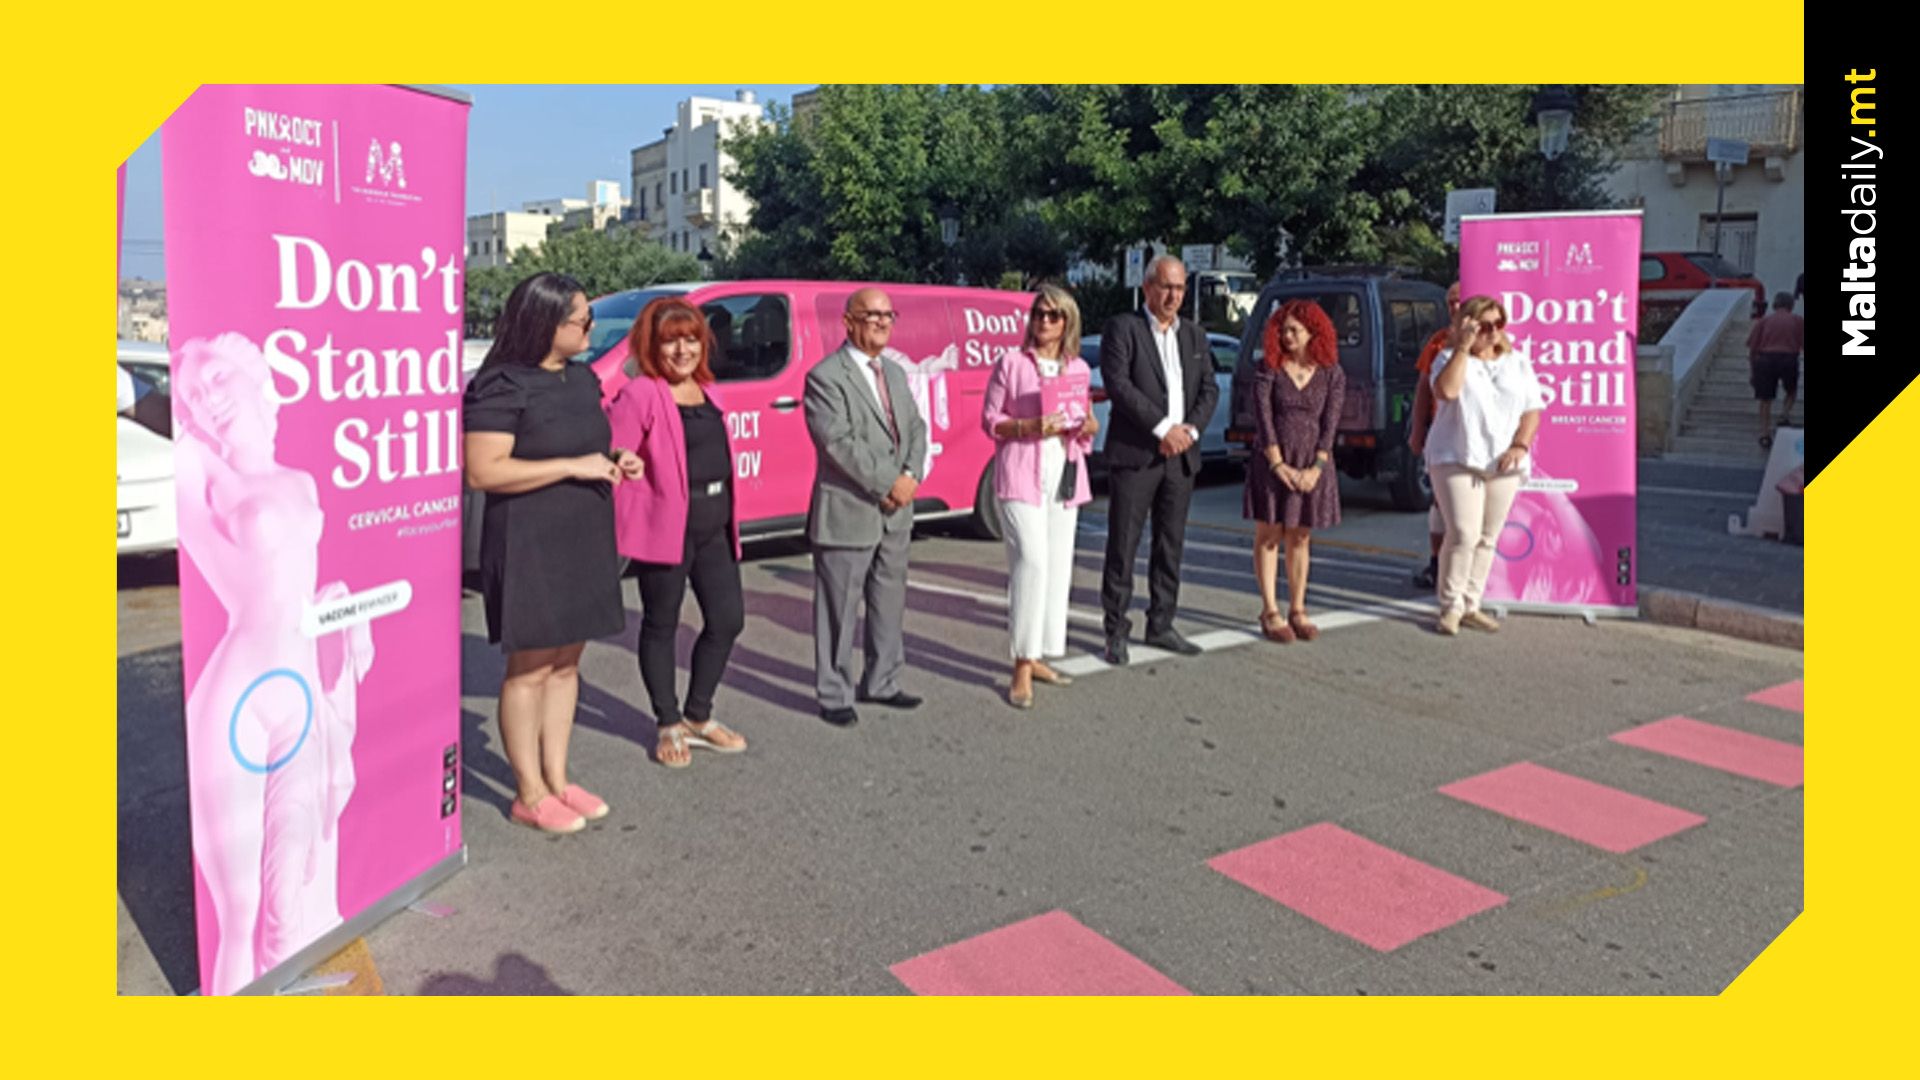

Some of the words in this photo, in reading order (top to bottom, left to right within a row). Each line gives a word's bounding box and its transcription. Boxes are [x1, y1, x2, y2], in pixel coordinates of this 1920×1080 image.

[289, 156, 323, 186] MOV
[263, 328, 460, 404] Stand
[1506, 330, 1627, 366] tand
[331, 408, 460, 490] Still
[348, 505, 410, 531] CERVICAL
